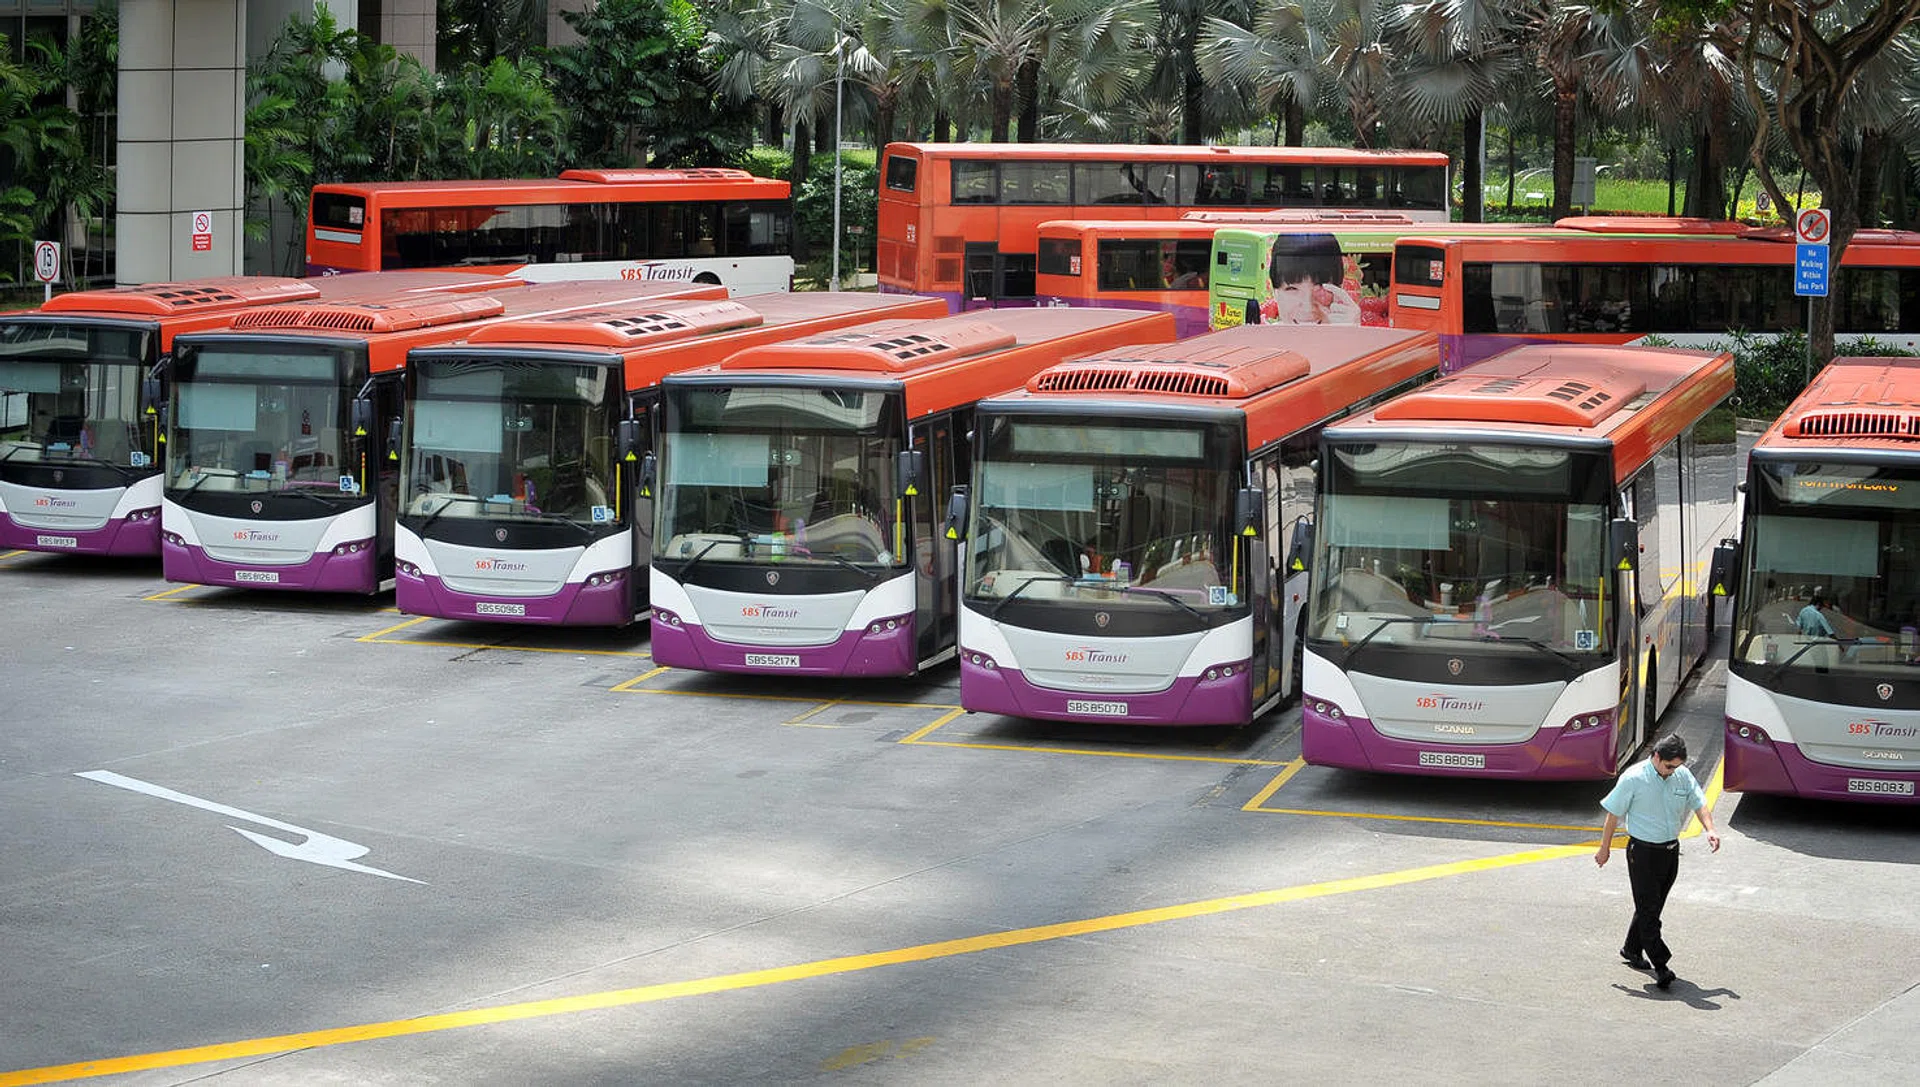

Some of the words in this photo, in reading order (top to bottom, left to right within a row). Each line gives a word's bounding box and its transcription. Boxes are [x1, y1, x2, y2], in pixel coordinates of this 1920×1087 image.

[42, 247, 52, 267] 15
[1808, 249, 1817, 257] No
[1800, 259, 1824, 271] Walking
[620, 267, 643, 281] SBS
[642, 263, 696, 281] Transit
[1801, 271, 1822, 279] Within
[1797, 281, 1810, 290] Bus
[1811, 282, 1825, 291] Park
[233, 531, 248, 541] SBS
[247, 530, 280, 541] Transit
[475, 560, 492, 570] SBS
[491, 559, 527, 571] Transit
[476, 603, 525, 615] SBS5096S
[741, 606, 760, 617] SBS
[759, 606, 800, 618] Transit
[746, 654, 798, 666] SBS5217K
[1065, 650, 1085, 661] SBS
[1085, 649, 1128, 663] Transit
[1068, 702, 1127, 714] SBS8507D
[1416, 697, 1438, 709] SBS
[1438, 696, 1485, 711] Transit
[1434, 724, 1476, 735] SCANIA
[1848, 722, 1871, 735] SBS
[1870, 721, 1920, 737] Transit
[1420, 753, 1484, 767] SBS8809H
[1862, 750, 1904, 760] SCANIA
[1849, 780, 1914, 794] SBS8083J
